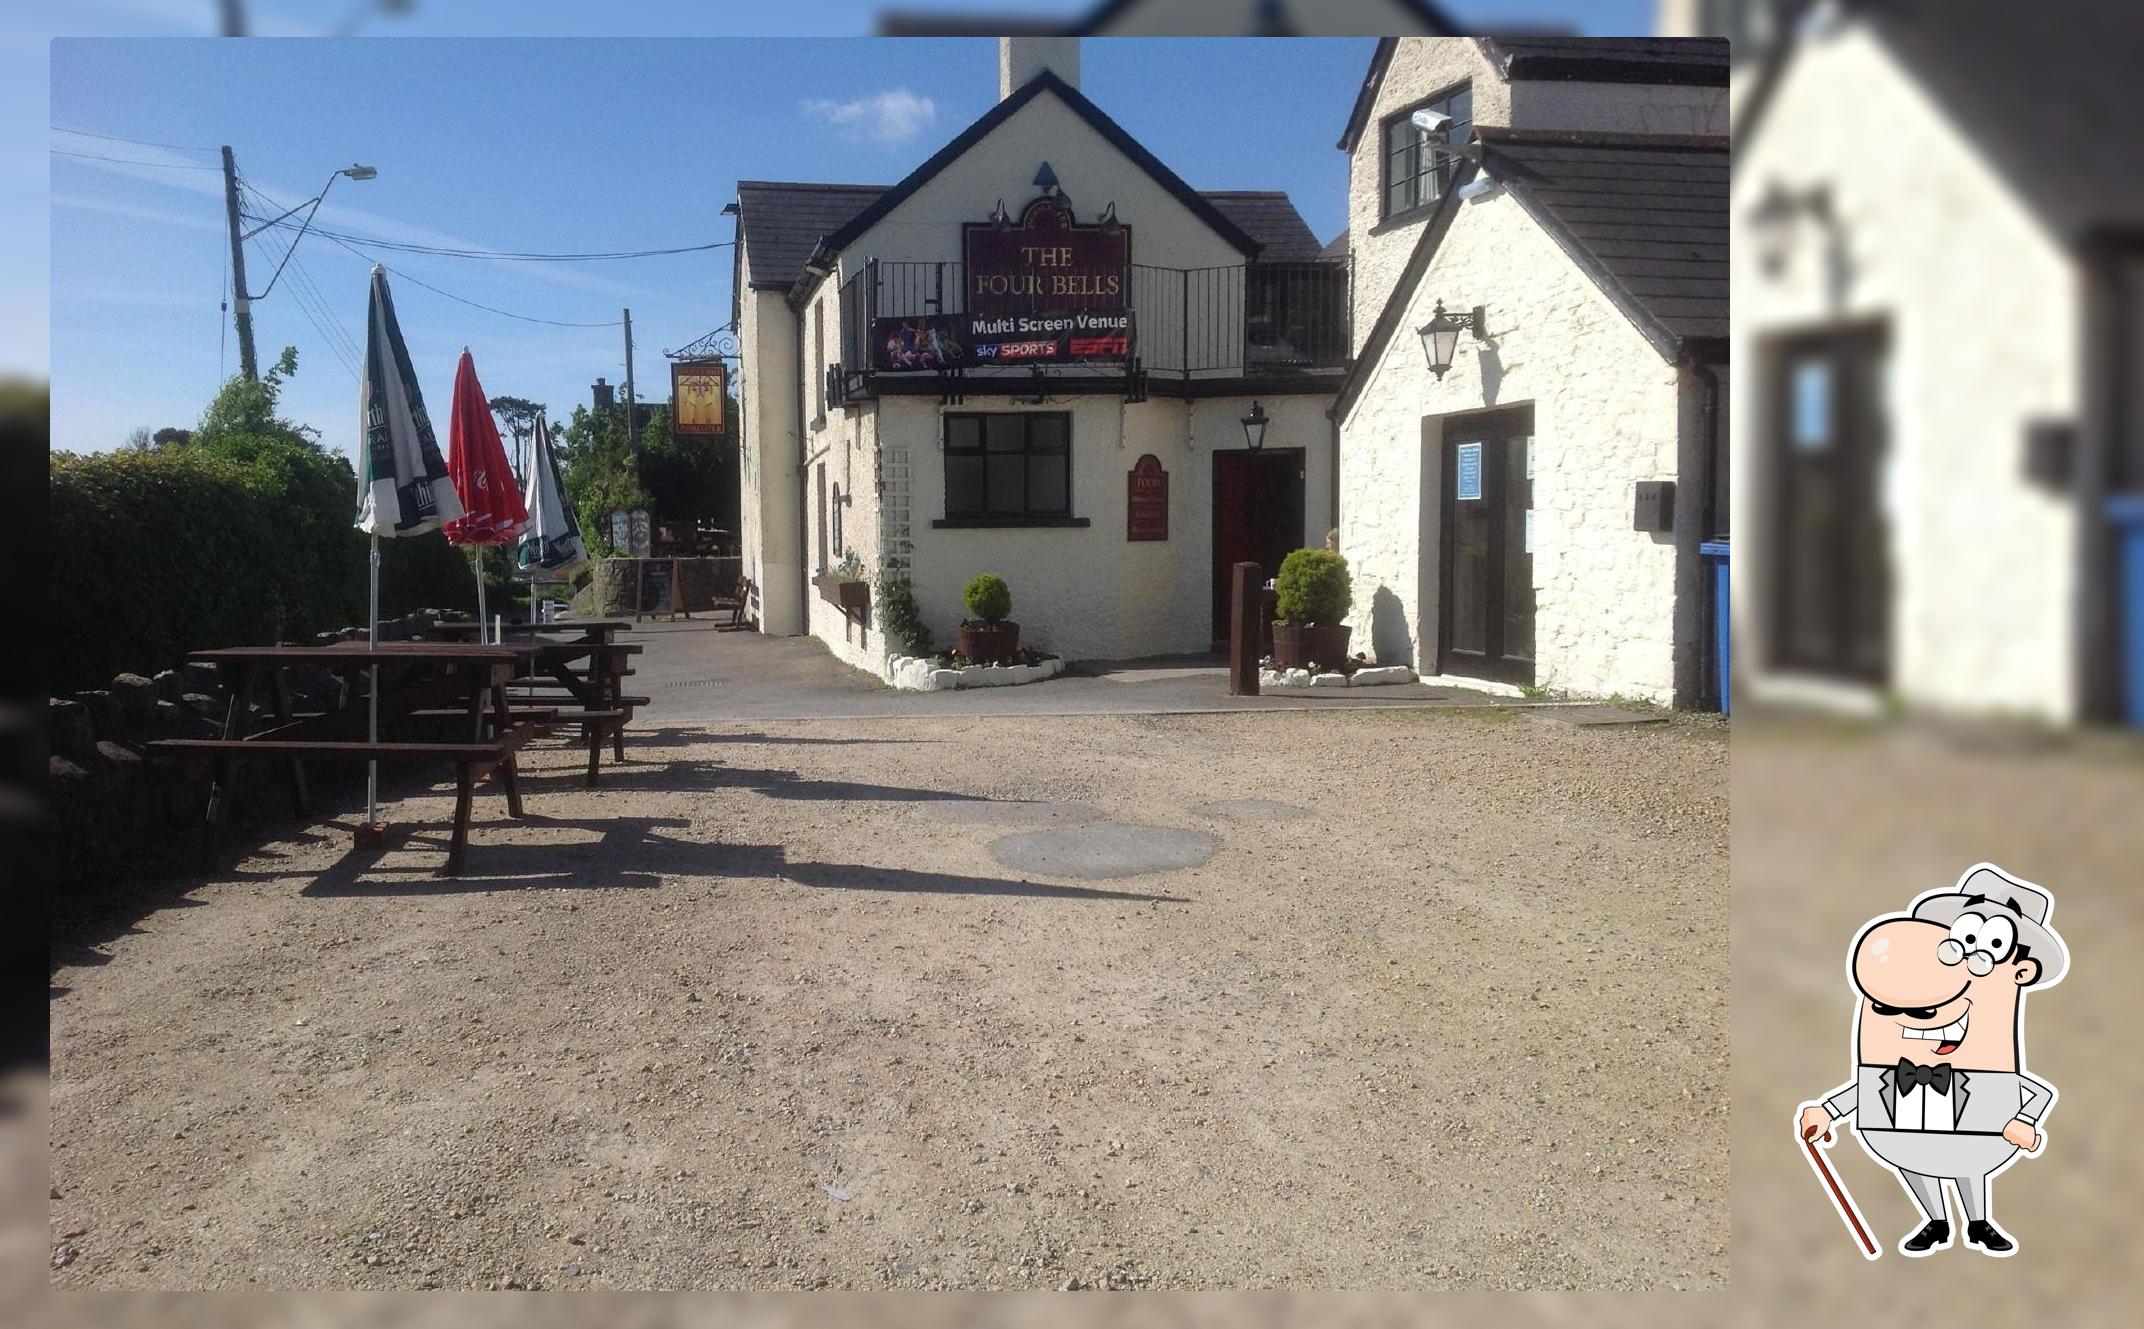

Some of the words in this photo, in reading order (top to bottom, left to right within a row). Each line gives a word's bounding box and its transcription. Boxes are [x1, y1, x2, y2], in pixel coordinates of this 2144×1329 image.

[1021, 247, 1073, 267] THE
[976, 275, 1043, 295] FOUR
[1052, 275, 1120, 295] BELLS
[972, 317, 1015, 335] Multi
[1018, 317, 1073, 333] Screen
[1076, 315, 1128, 330] Venue
[976, 344, 998, 358] sky
[1001, 342, 1055, 356] SPORTS
